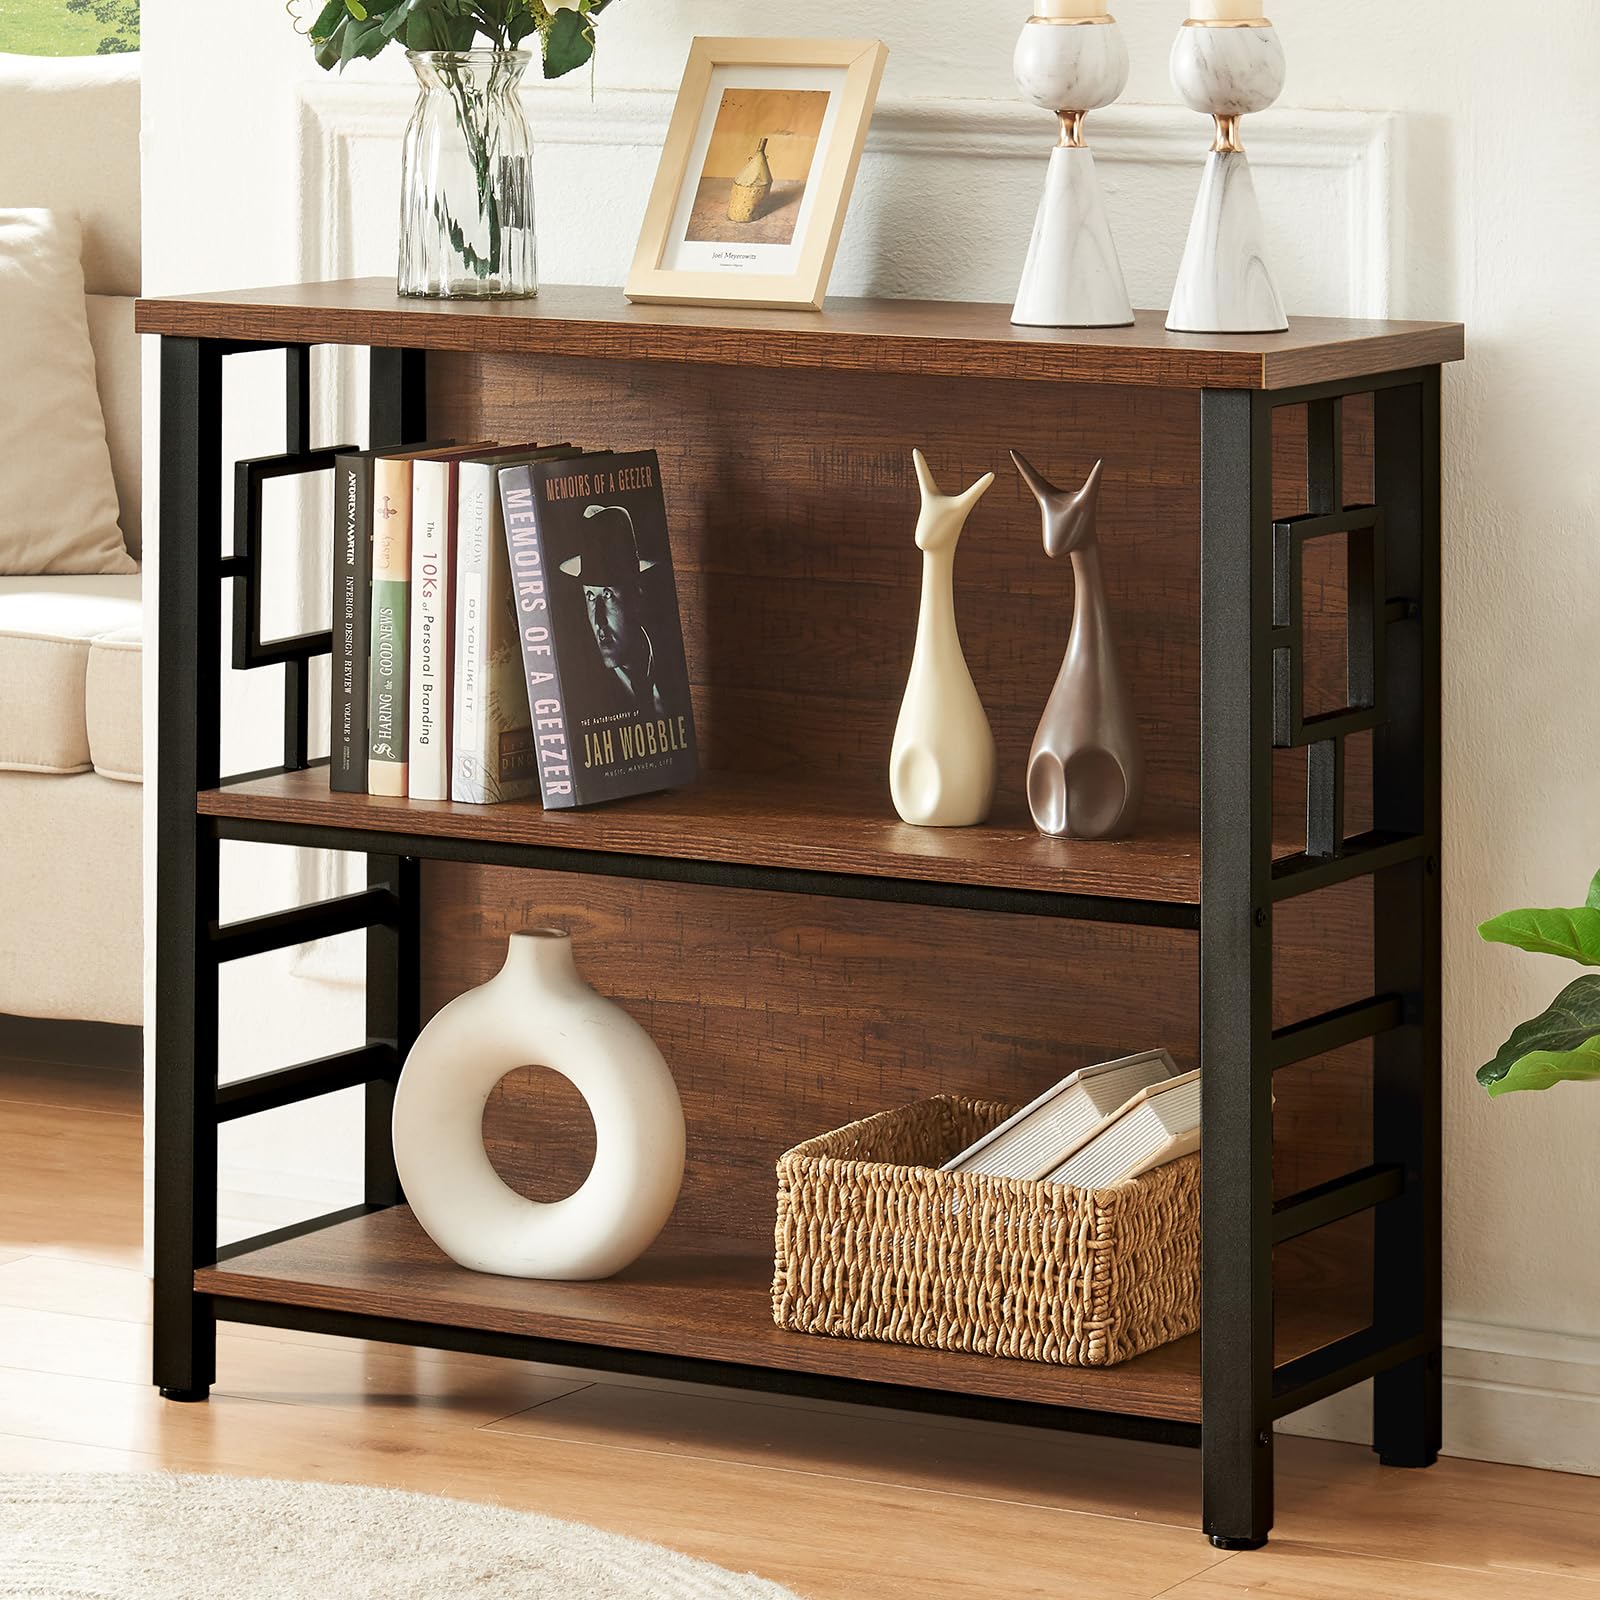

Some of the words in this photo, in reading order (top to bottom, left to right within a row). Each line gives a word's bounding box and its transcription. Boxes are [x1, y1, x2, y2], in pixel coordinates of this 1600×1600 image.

[712, 252, 723, 260] Joel
[348, 470, 356, 521] ANDREW
[546, 474, 591, 501] MEMOIRS
[594, 473, 605, 495] OF
[609, 473, 616, 493] A
[619, 466, 653, 491] GEEZER
[346, 522, 355, 565] MARTIN
[427, 521, 435, 538] The
[473, 492, 483, 563] SIDESHOW
[505, 488, 547, 612] MEMOIRS
[423, 553, 438, 598] 10Ks
[345, 576, 354, 619] INTERIOR
[422, 602, 430, 612] of
[468, 598, 475, 619] DO
[344, 623, 353, 656] DESIGN
[379, 607, 393, 640] NEWS
[467, 625, 475, 655] YOU
[422, 615, 434, 677] Personal
[524, 626, 551, 656] OF
[379, 641, 393, 676] GOOD
[466, 659, 474, 691] LIKE
[344, 660, 352, 694] REVIEW
[530, 671, 554, 685] A
[343, 702, 351, 735] VOLUME
[419, 684, 433, 745] Branding
[465, 697, 473, 711] IT
[581, 718, 590, 726] THE
[633, 709, 640, 717] OF
[534, 698, 572, 796] GEEZER
[584, 729, 614, 768] JAH
[619, 716, 688, 761] WOBBLE
[659, 757, 673, 767] LIFE
